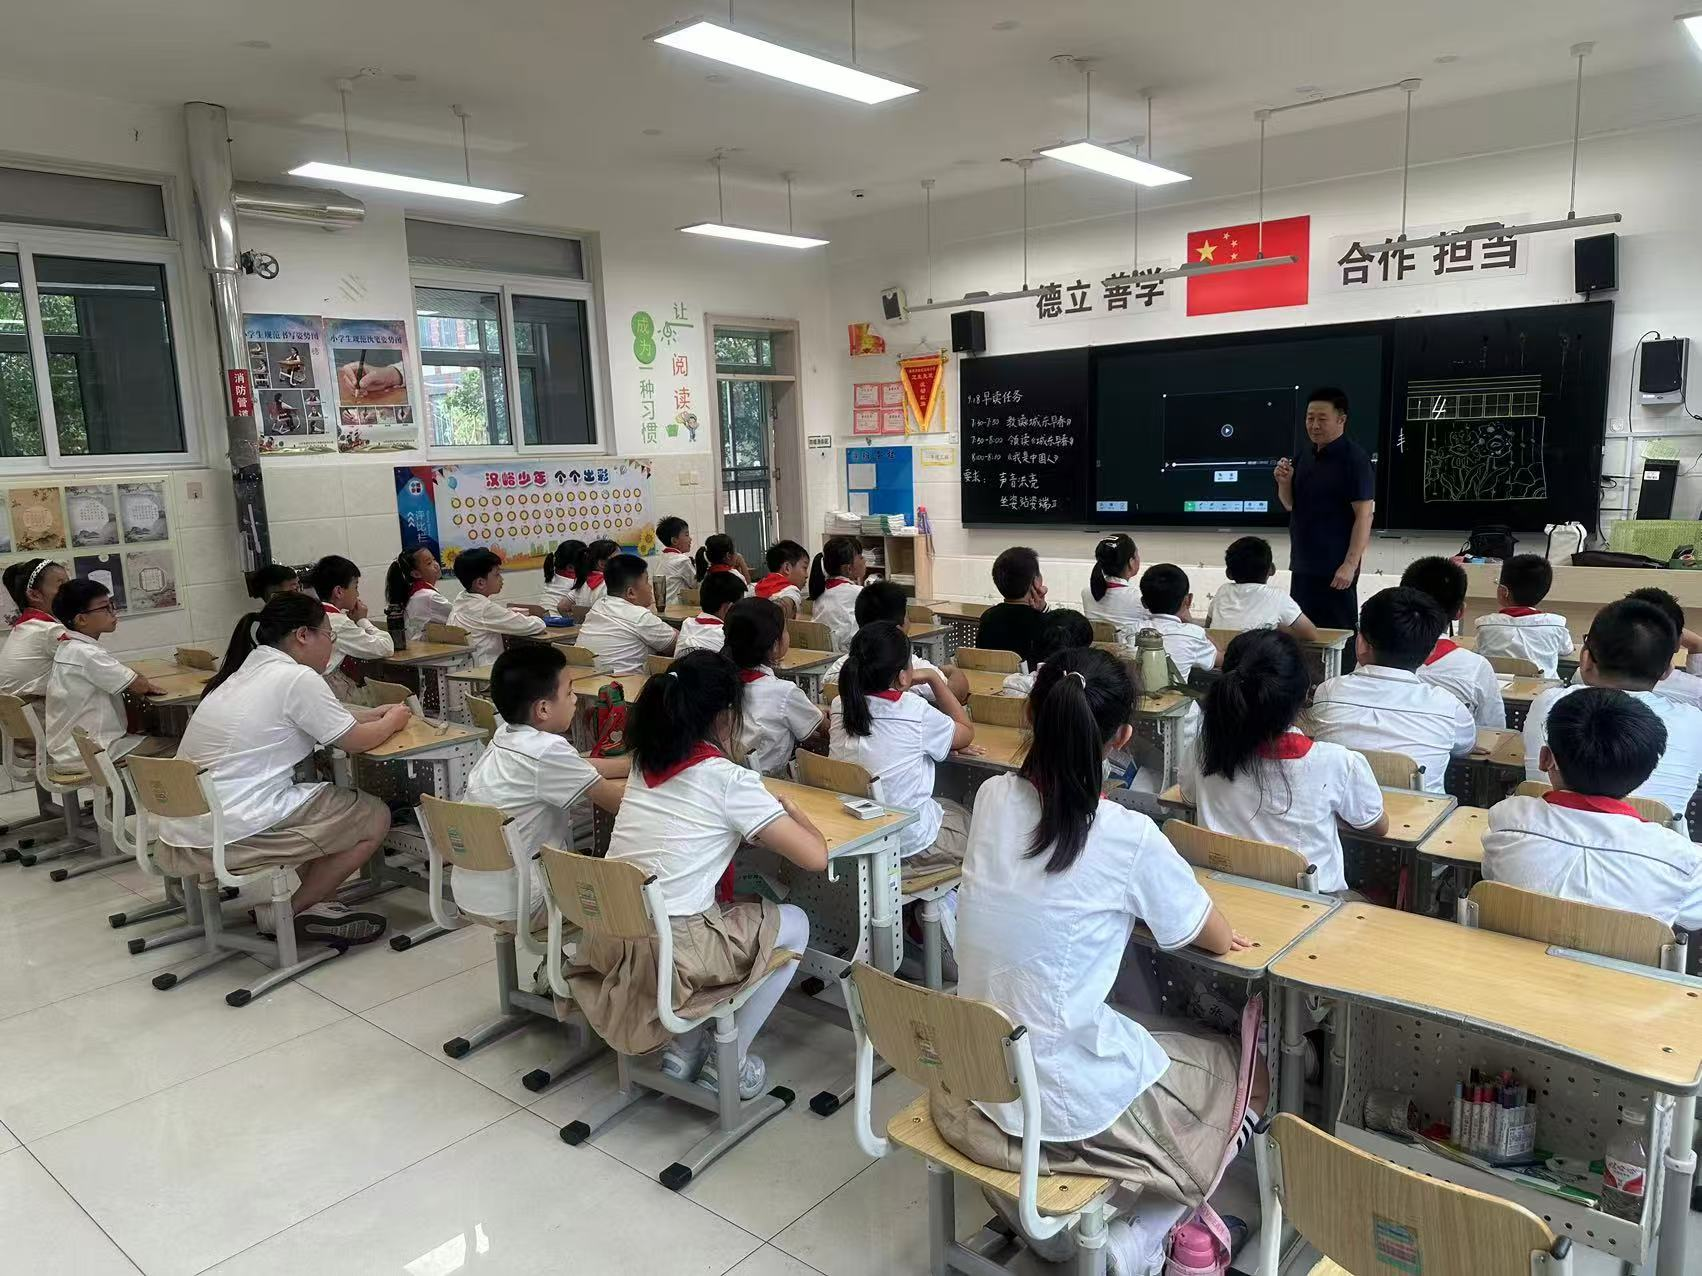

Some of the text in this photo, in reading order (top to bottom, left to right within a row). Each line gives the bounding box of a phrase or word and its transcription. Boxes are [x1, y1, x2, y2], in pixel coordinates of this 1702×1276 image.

[1337, 226, 1518, 285] 合作 担当
[1036, 267, 1164, 319] 德立 善学
[245, 329, 320, 341] 学生规范书写姿势图
[233, 372, 249, 417] 消防管道
[485, 468, 609, 487] 汉峪少年 个个出彩
